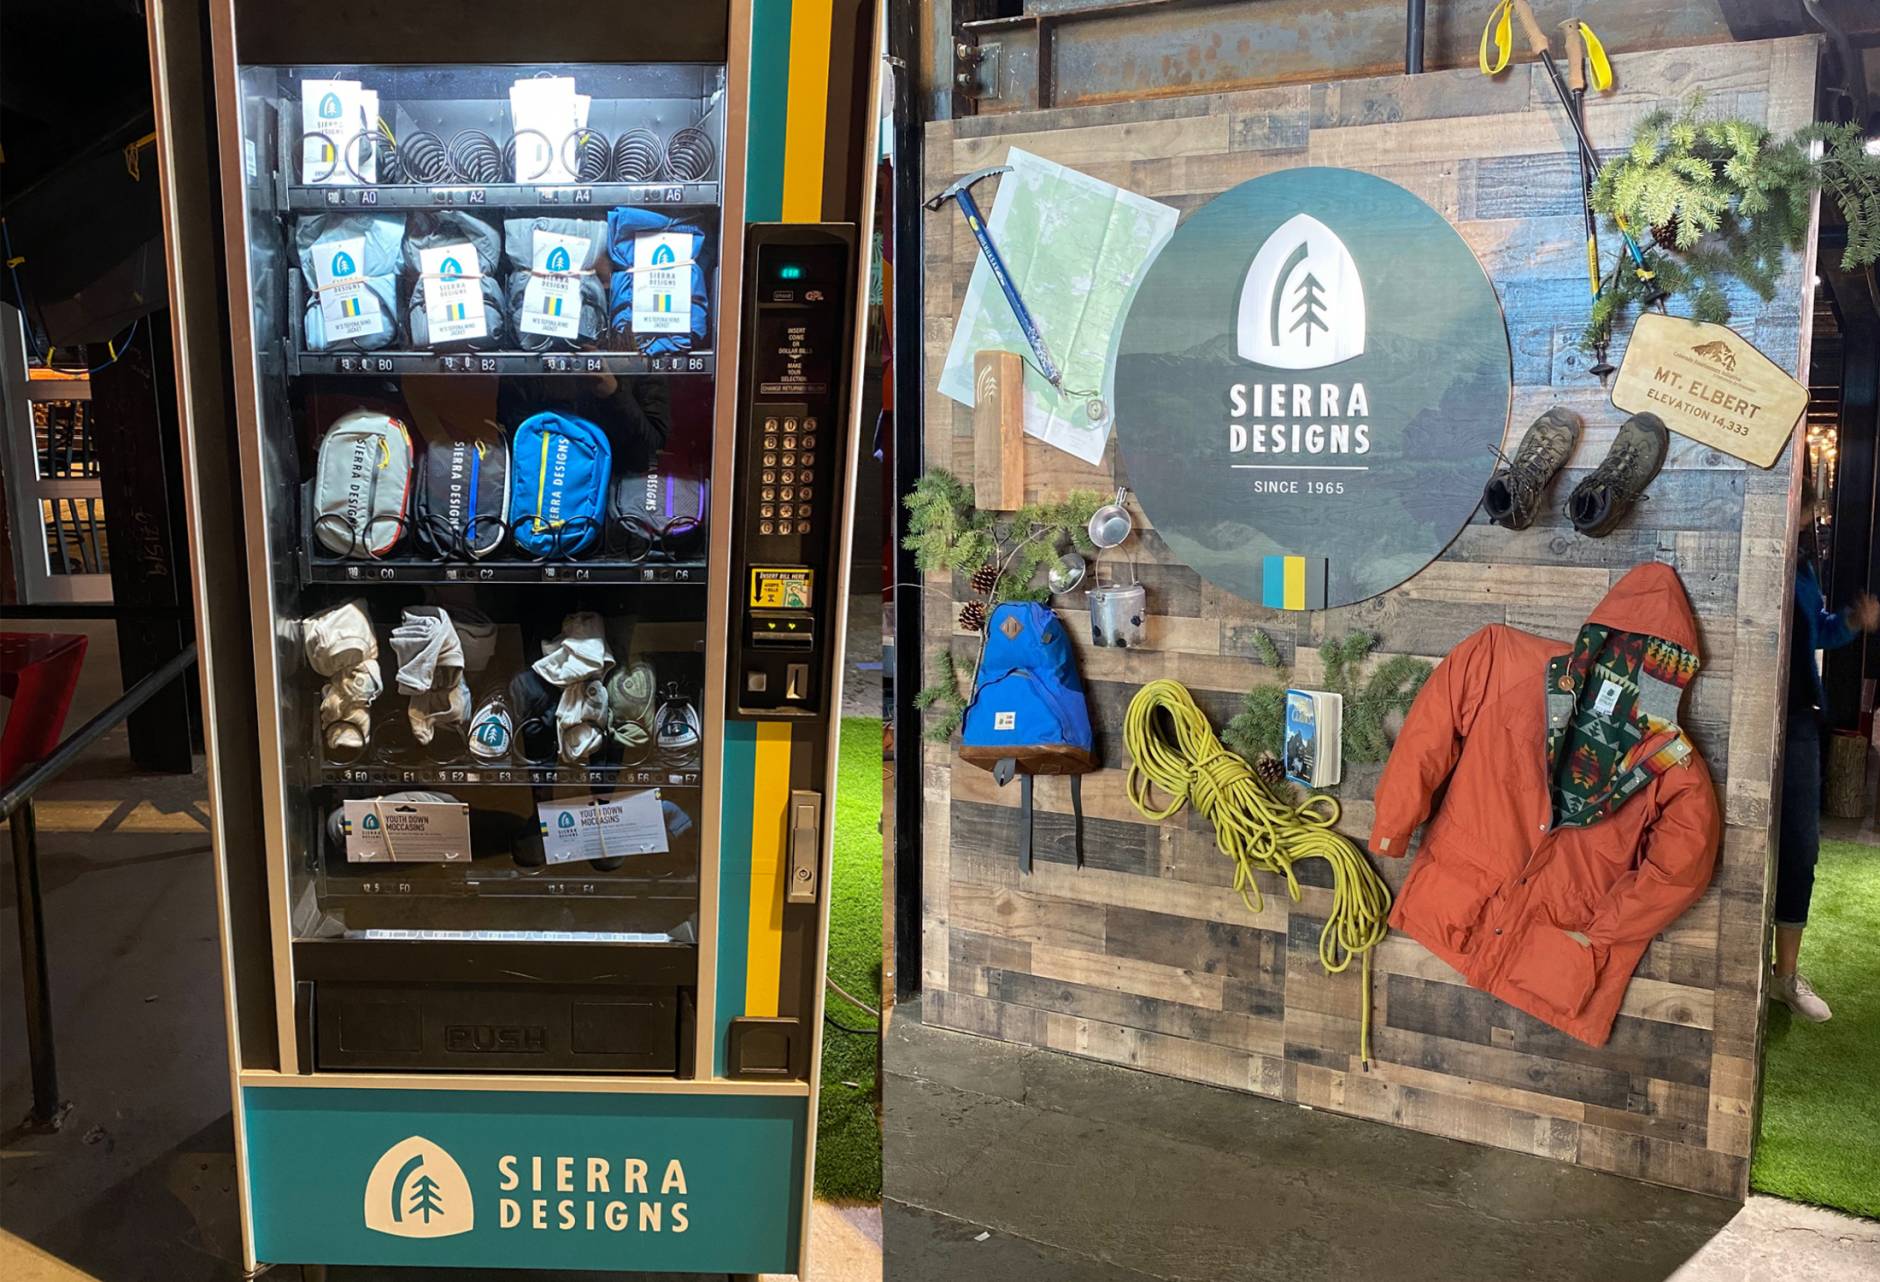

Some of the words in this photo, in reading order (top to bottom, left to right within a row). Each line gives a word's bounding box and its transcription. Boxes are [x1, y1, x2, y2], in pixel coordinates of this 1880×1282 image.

[361, 191, 377, 204] A0
[469, 190, 484, 203] A2
[575, 190, 590, 202] A4
[666, 189, 681, 201] A6
[378, 359, 392, 371] B0
[481, 359, 496, 371] B2
[587, 359, 601, 371] B4
[689, 358, 703, 370] B6
[1653, 366, 1683, 391] MT.
[1688, 380, 1761, 419] ELBERT
[1229, 383, 1369, 418] SIERRA
[1647, 387, 1711, 421] ELEVATION
[1711, 414, 1750, 437] 14,333
[1229, 424, 1370, 455] DESIGNS
[351, 439, 366, 479] SIERRA
[451, 441, 465, 480] SIERRA
[549, 491, 562, 527] IERRA
[558, 438, 570, 486] DESIGNS
[1254, 480, 1299, 494] SINCE
[1306, 481, 1345, 495] 1965
[645, 473, 658, 511] DESIGNS
[380, 568, 394, 579] C0
[480, 569, 494, 580] C2
[576, 569, 589, 580] C4
[675, 570, 689, 580] C6
[355, 771, 368, 782] E0
[403, 772, 415, 782] E1
[451, 771, 464, 782] E2
[602, 806, 623, 815] DOWN
[385, 815, 406, 824] YOUTH
[408, 815, 429, 824] DOWN
[386, 823, 425, 832] MOCCASINS
[449, 1026, 546, 1050] PUSH
[498, 1155, 688, 1195] SIERRA
[499, 1198, 689, 1233] DESIGNS
